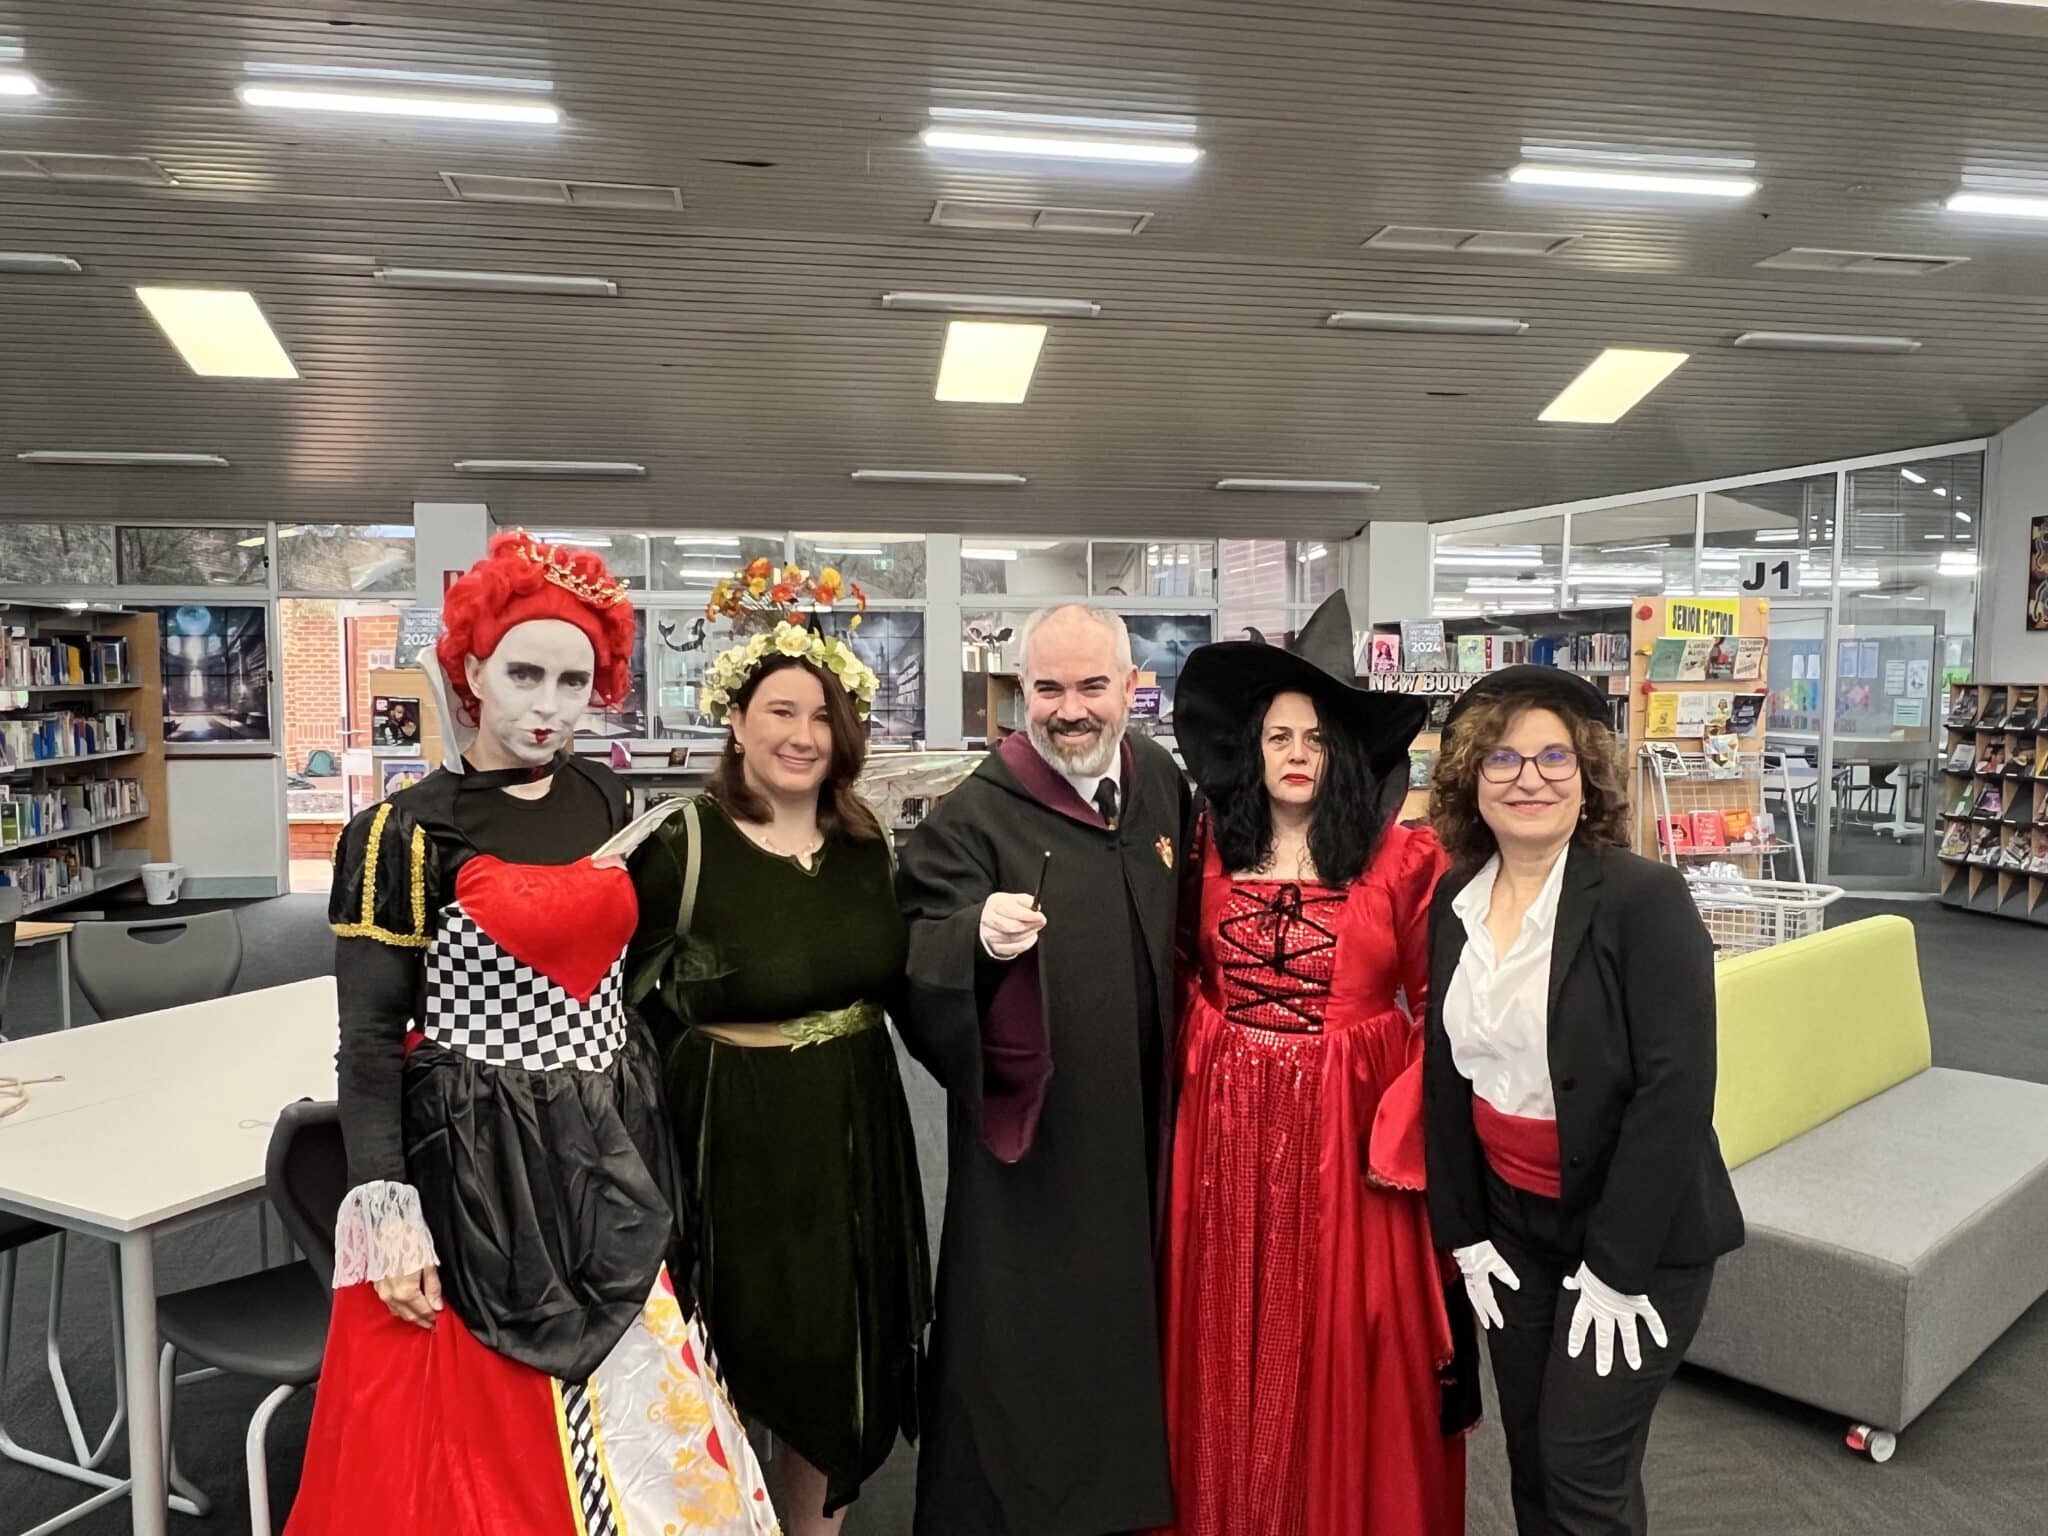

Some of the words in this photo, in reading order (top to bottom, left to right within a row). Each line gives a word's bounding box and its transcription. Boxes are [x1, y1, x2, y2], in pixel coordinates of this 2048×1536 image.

[1742, 561, 1789, 590] J1
[1672, 605, 1701, 633] SENIOR
[1703, 609, 1733, 636] FICTION
[404, 633, 436, 646] 2024
[1411, 642, 1440, 652] 2024
[1370, 673, 1418, 693] NEW
[1422, 673, 1482, 693] BOOK
